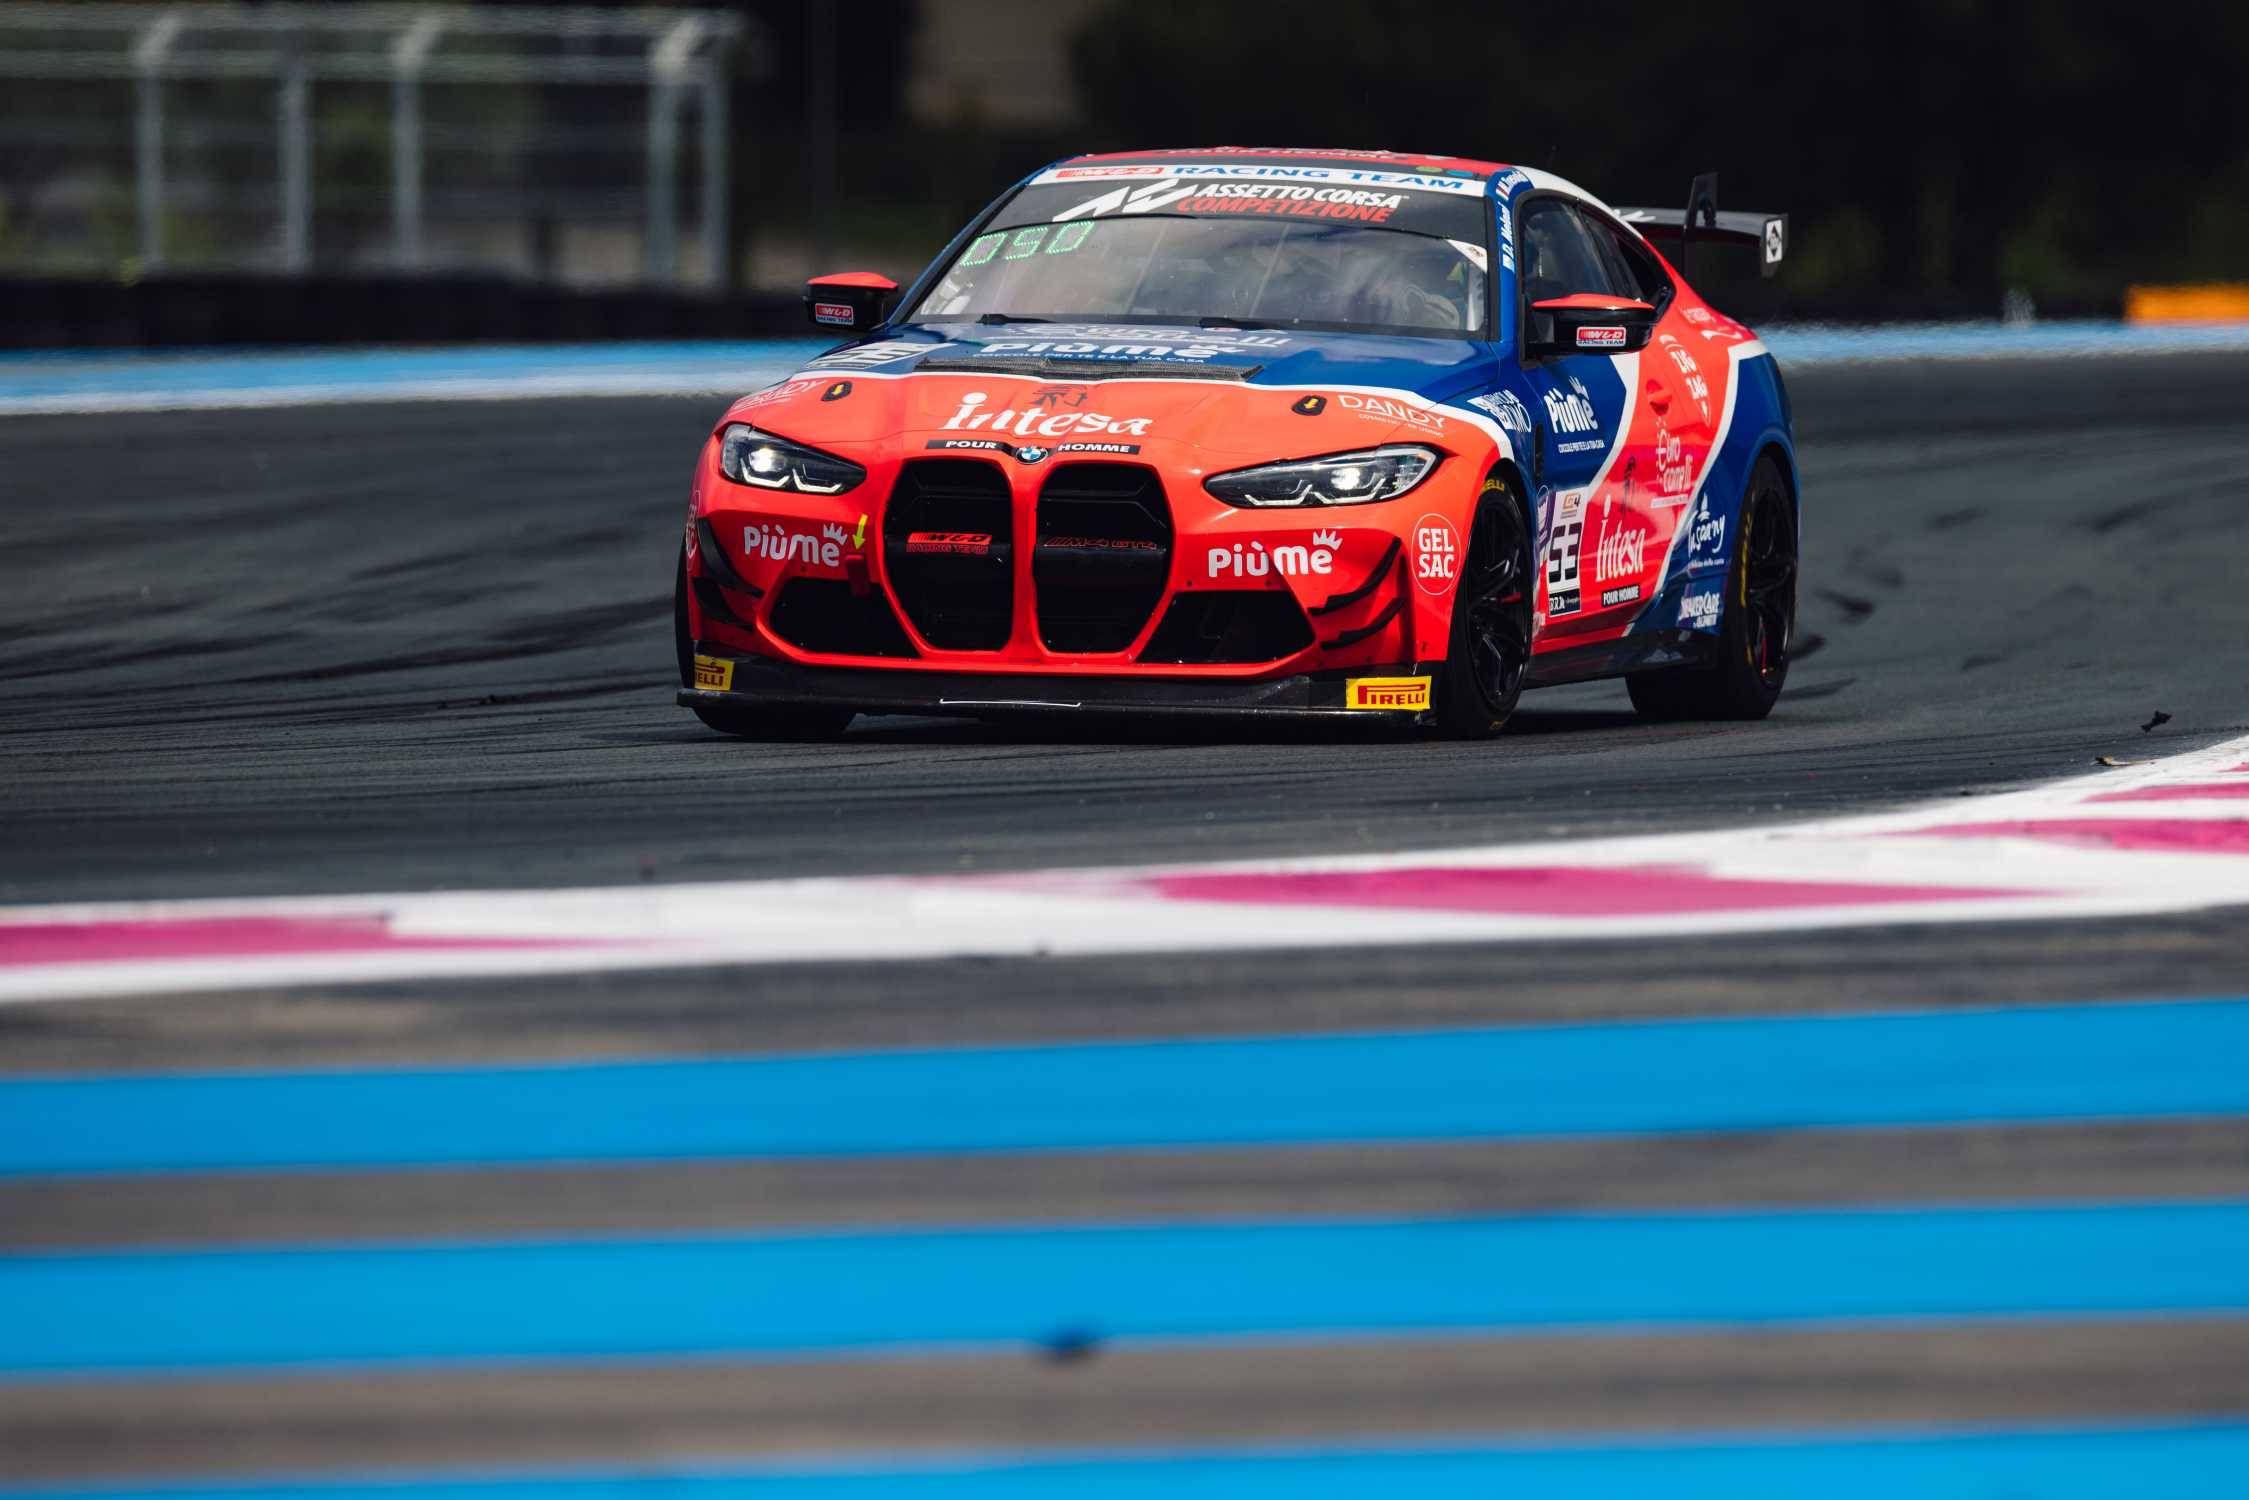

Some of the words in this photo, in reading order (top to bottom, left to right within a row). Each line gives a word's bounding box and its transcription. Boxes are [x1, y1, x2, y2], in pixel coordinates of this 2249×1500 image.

[1174, 166, 1329, 179] RACING
[1349, 172, 1465, 190] TEAM
[1193, 184, 1313, 200] ASSETTO
[1311, 187, 1402, 209] CORSA
[1176, 197, 1397, 223] COMPETIZIONE
[1338, 395, 1446, 429] DANDY
[945, 441, 997, 449] POUR
[1058, 443, 1130, 453] HOMME
[930, 533, 985, 543] W&D
[1418, 528, 1455, 552] GEL
[1549, 522, 1582, 584] 53
[1418, 553, 1455, 578] SAC
[1603, 590, 1619, 606] POUR
[1620, 585, 1640, 602] HOMME
[1358, 684, 1426, 705] PIRELLI
